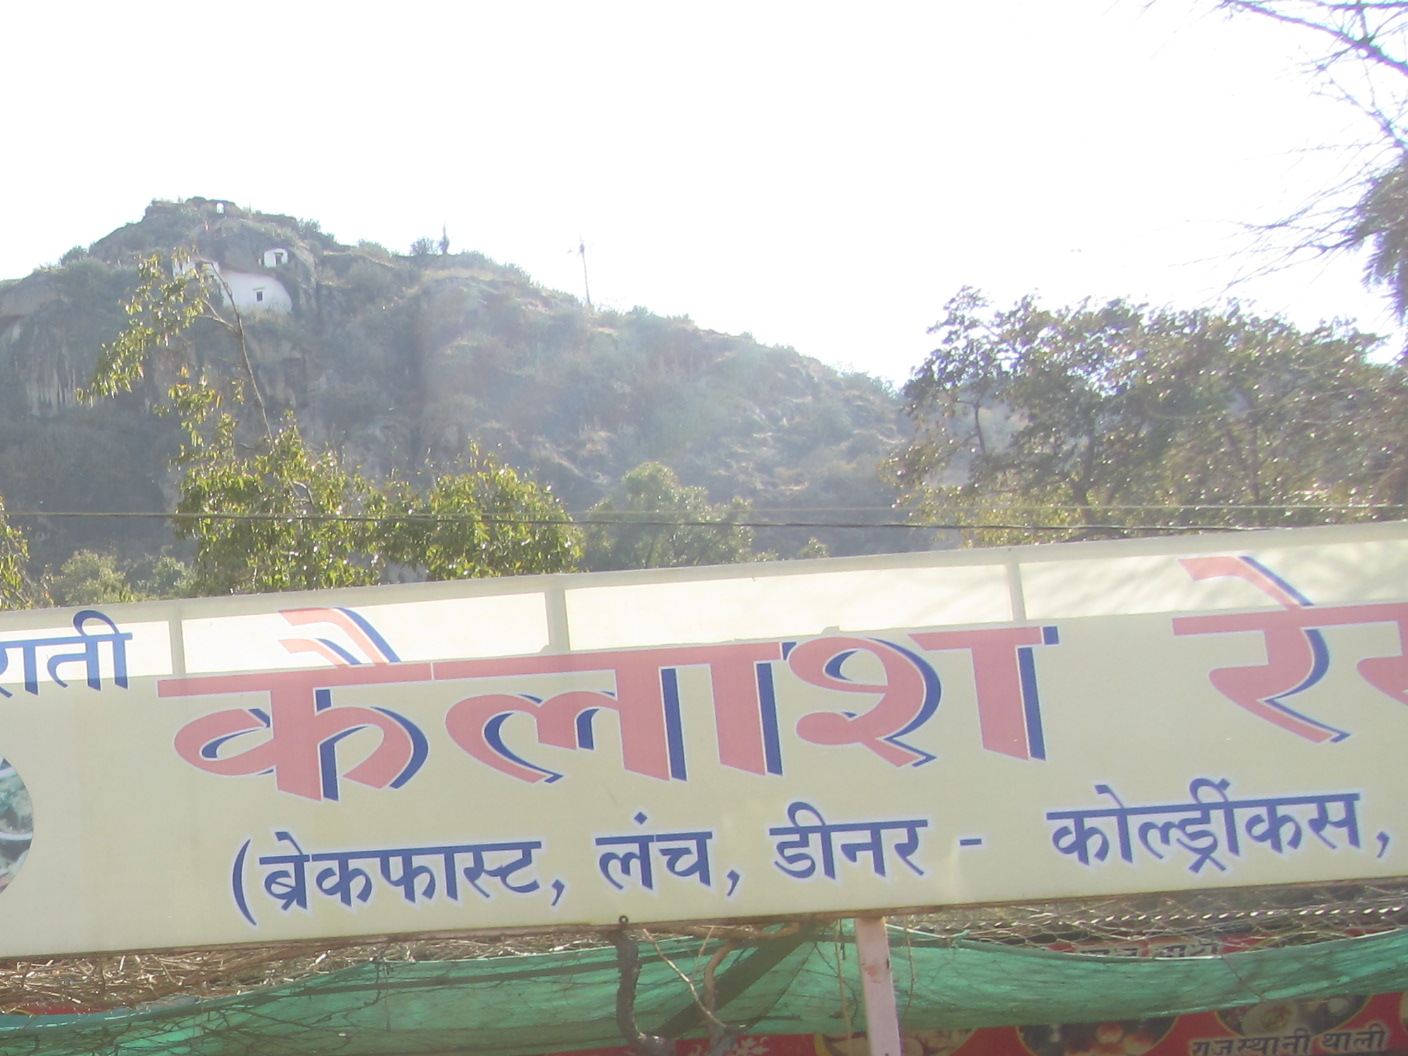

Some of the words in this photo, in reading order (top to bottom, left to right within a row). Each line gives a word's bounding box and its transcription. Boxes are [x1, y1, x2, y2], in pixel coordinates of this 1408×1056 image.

[157, 606, 1059, 802] कैलाश
[595, 811, 740, 897] लंच,
[769, 801, 928, 880] डीनर
[1322, 1023, 1386, 1051] थाली
